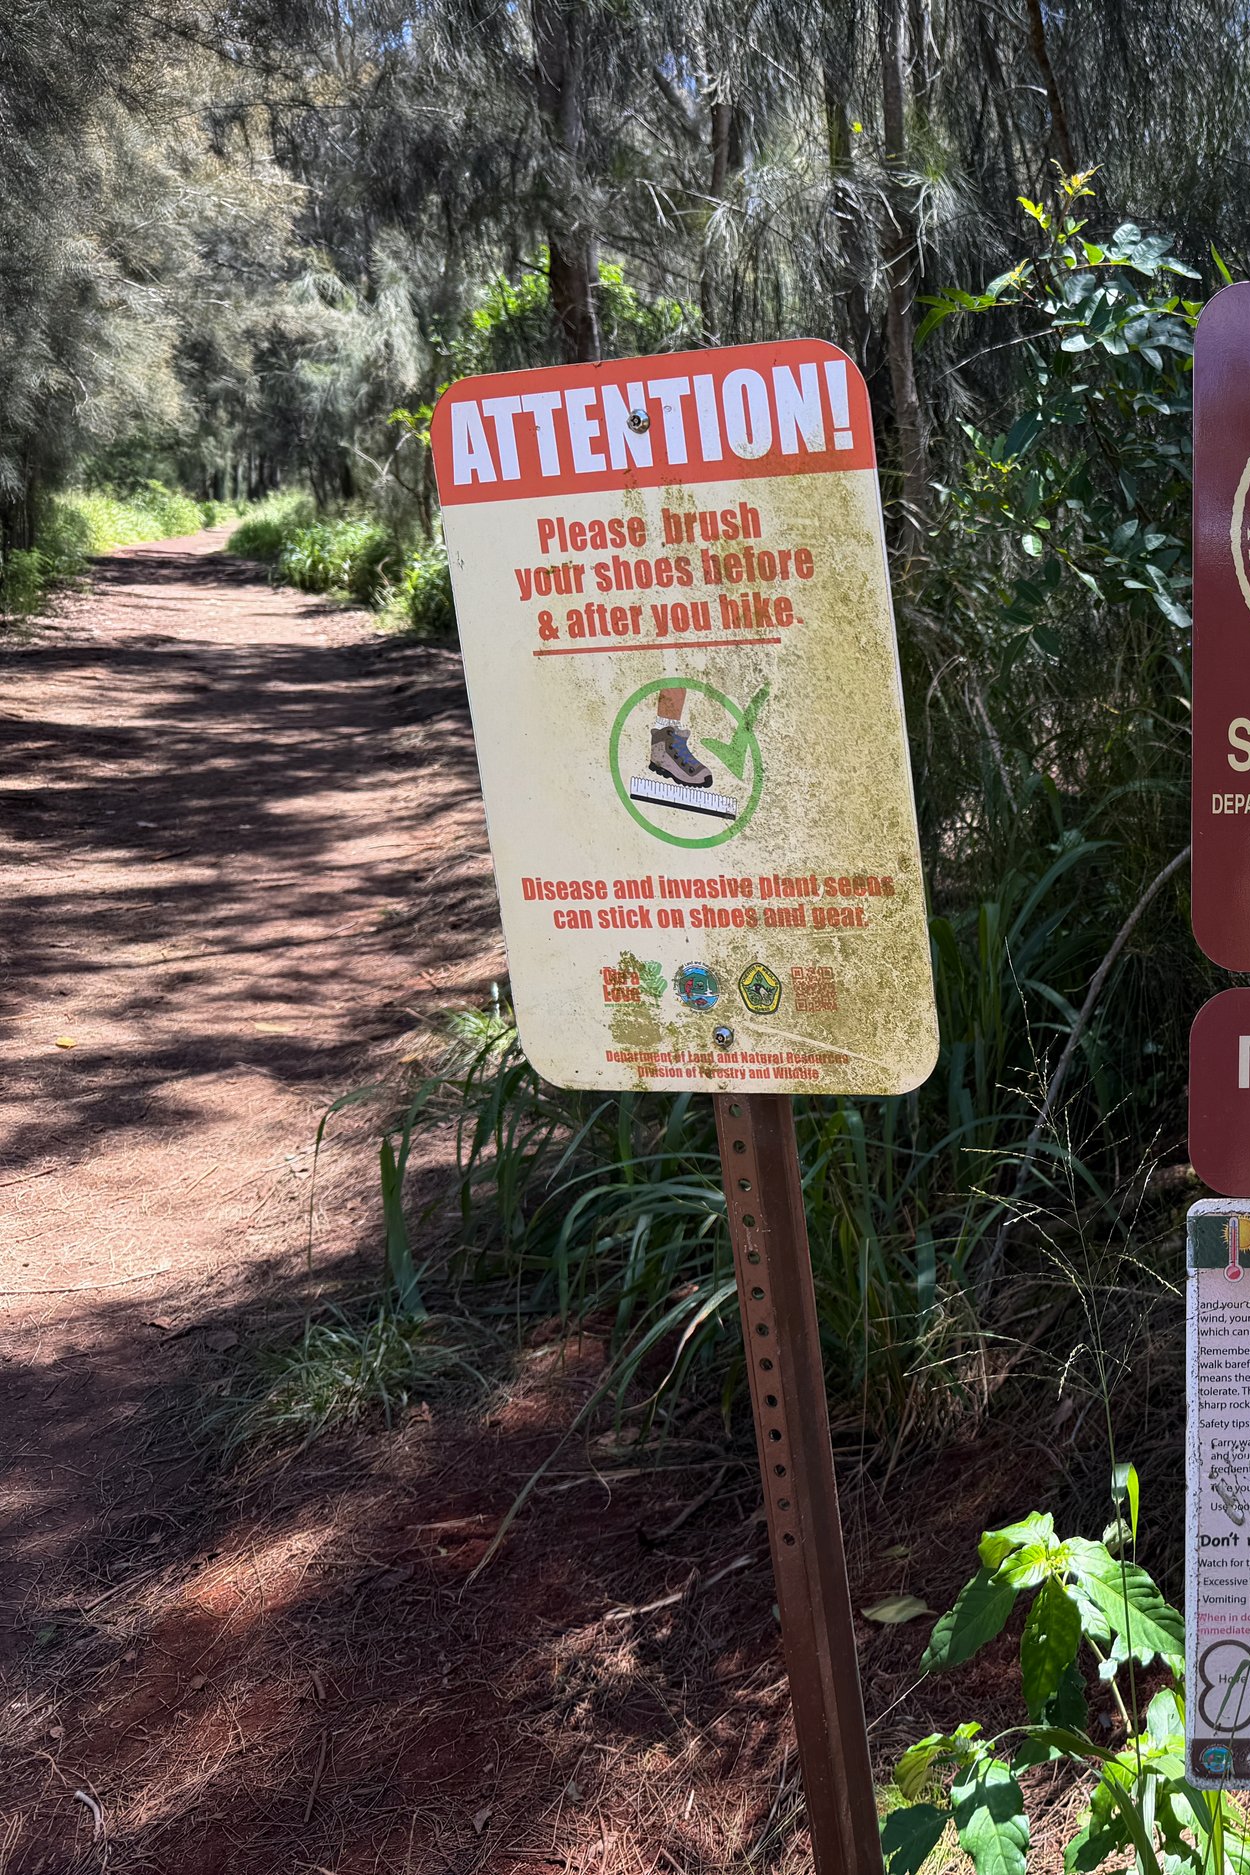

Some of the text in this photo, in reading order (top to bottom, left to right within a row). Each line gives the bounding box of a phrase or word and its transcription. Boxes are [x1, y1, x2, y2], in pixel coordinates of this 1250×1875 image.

[450, 360, 855, 485] ATTENTION!
[537, 501, 761, 554] Please brush
[515, 544, 815, 601] your shoes before
[538, 592, 804, 641] & after you hike.
[521, 872, 895, 901] Disease and invasive plant seeds
[553, 904, 869, 930] can stick on shoes and gear.
[606, 1051, 848, 1064] Department of Land and Natural Resources
[638, 1066, 819, 1080] Division of Forestry and Wildlife
[1200, 1301, 1219, 1309] and
[1222, 1302, 1245, 1312] your
[1200, 1314, 1227, 1324] wind,
[1230, 1315, 1250, 1324] your
[1200, 1328, 1229, 1337] which
[1203, 1577, 1248, 1586] Excessive
[1203, 1595, 1246, 1607] Vomiting
[1219, 1674, 1246, 1683] Have
